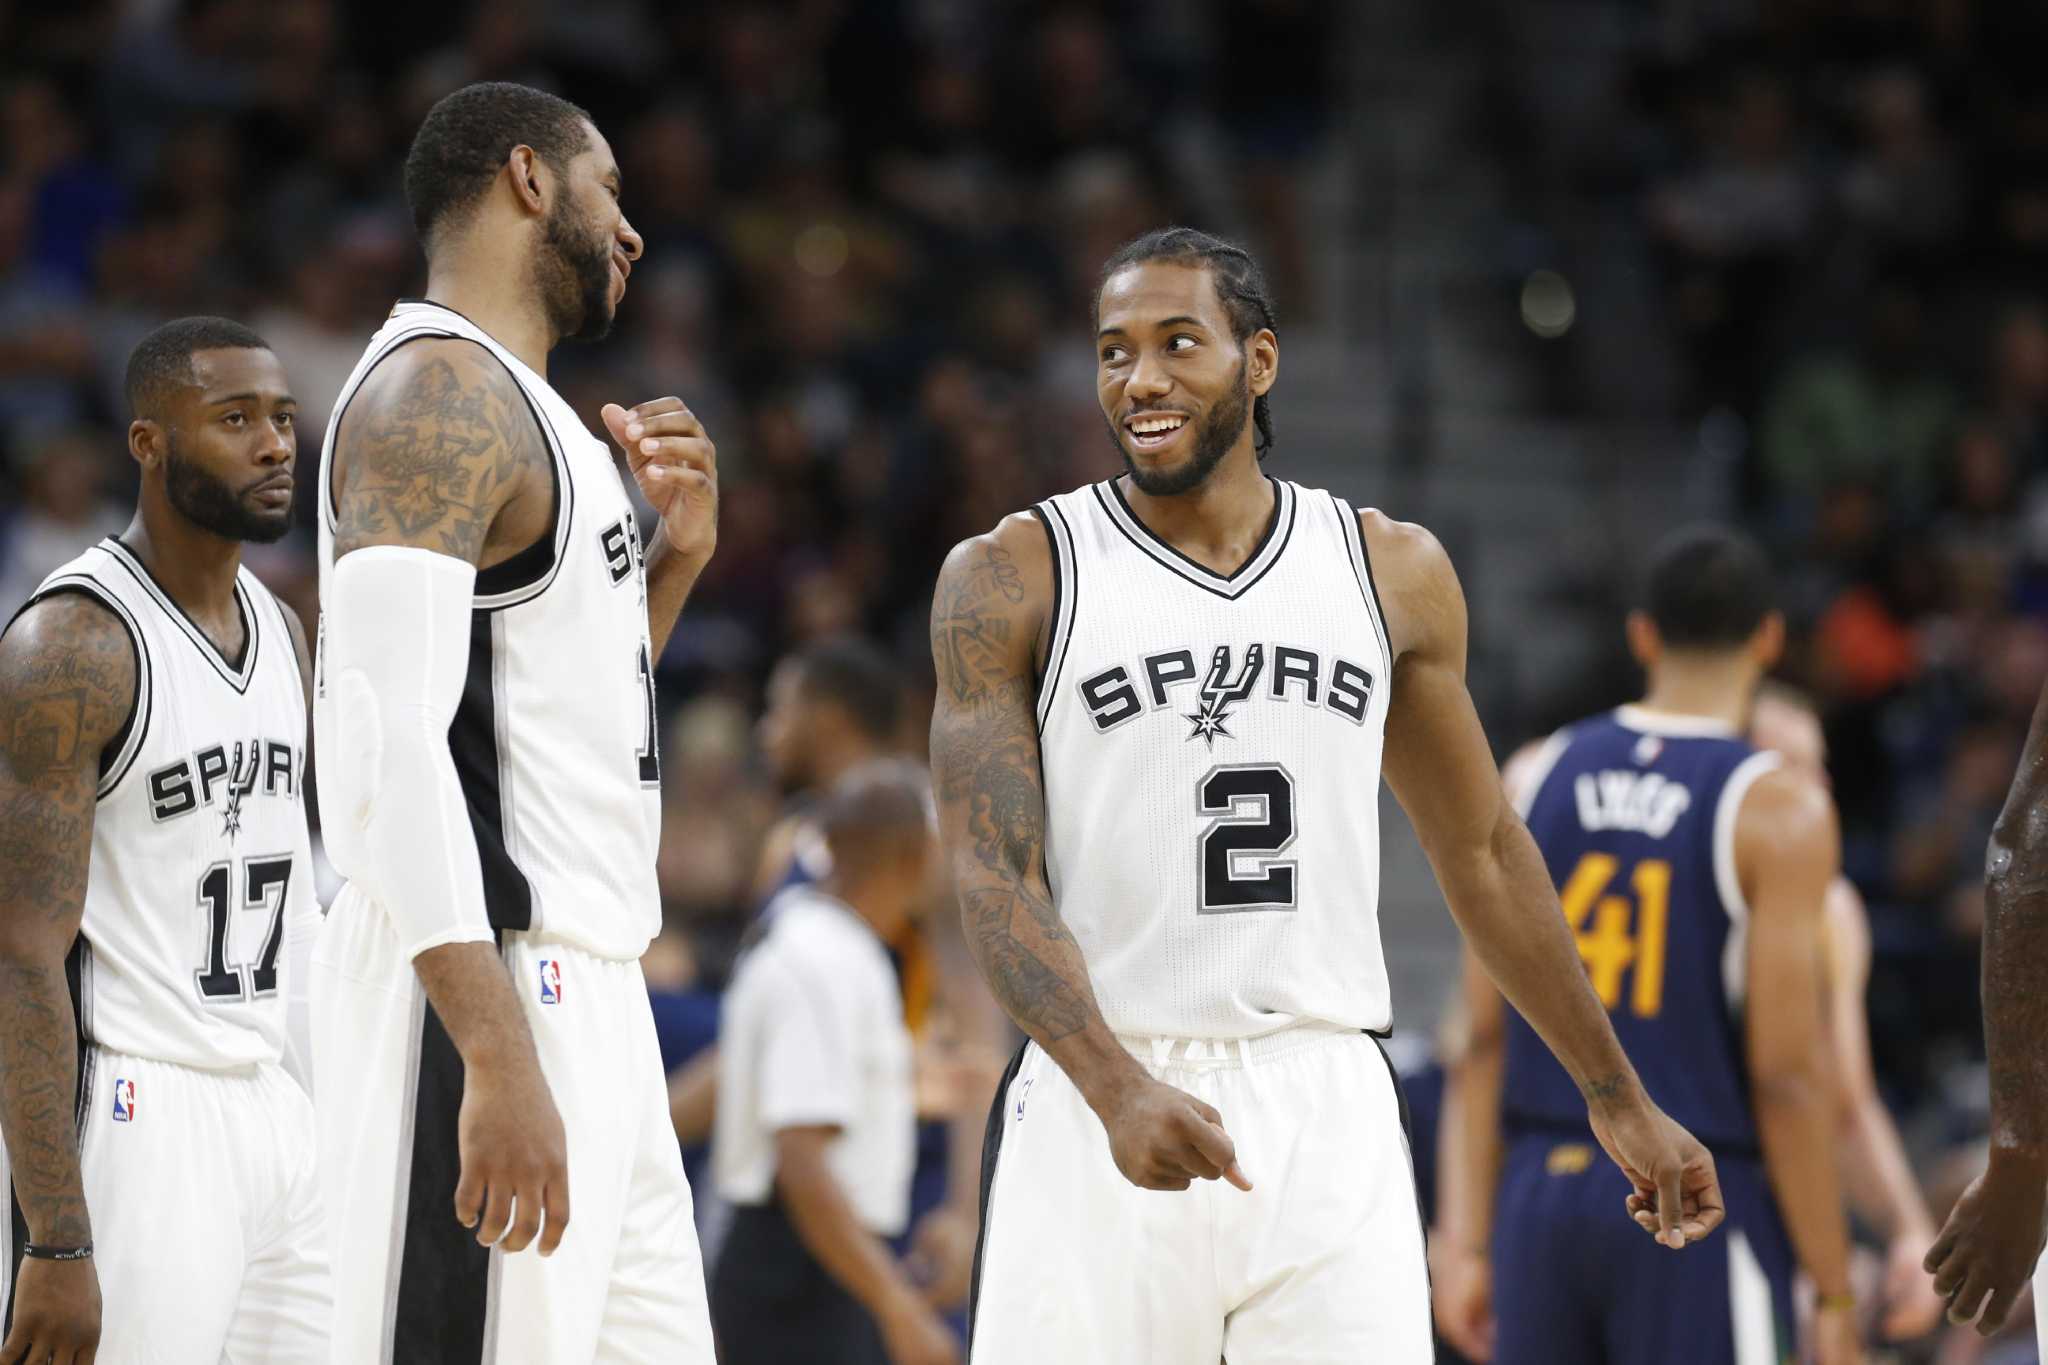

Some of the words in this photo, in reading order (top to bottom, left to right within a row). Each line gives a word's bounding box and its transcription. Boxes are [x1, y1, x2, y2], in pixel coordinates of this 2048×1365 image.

[1077, 643, 1377, 734] SPURS
[146, 739, 304, 825] SPUR
[1196, 762, 1299, 915] 2
[193, 851, 294, 1004] 17
[1559, 853, 1672, 1019] 41
